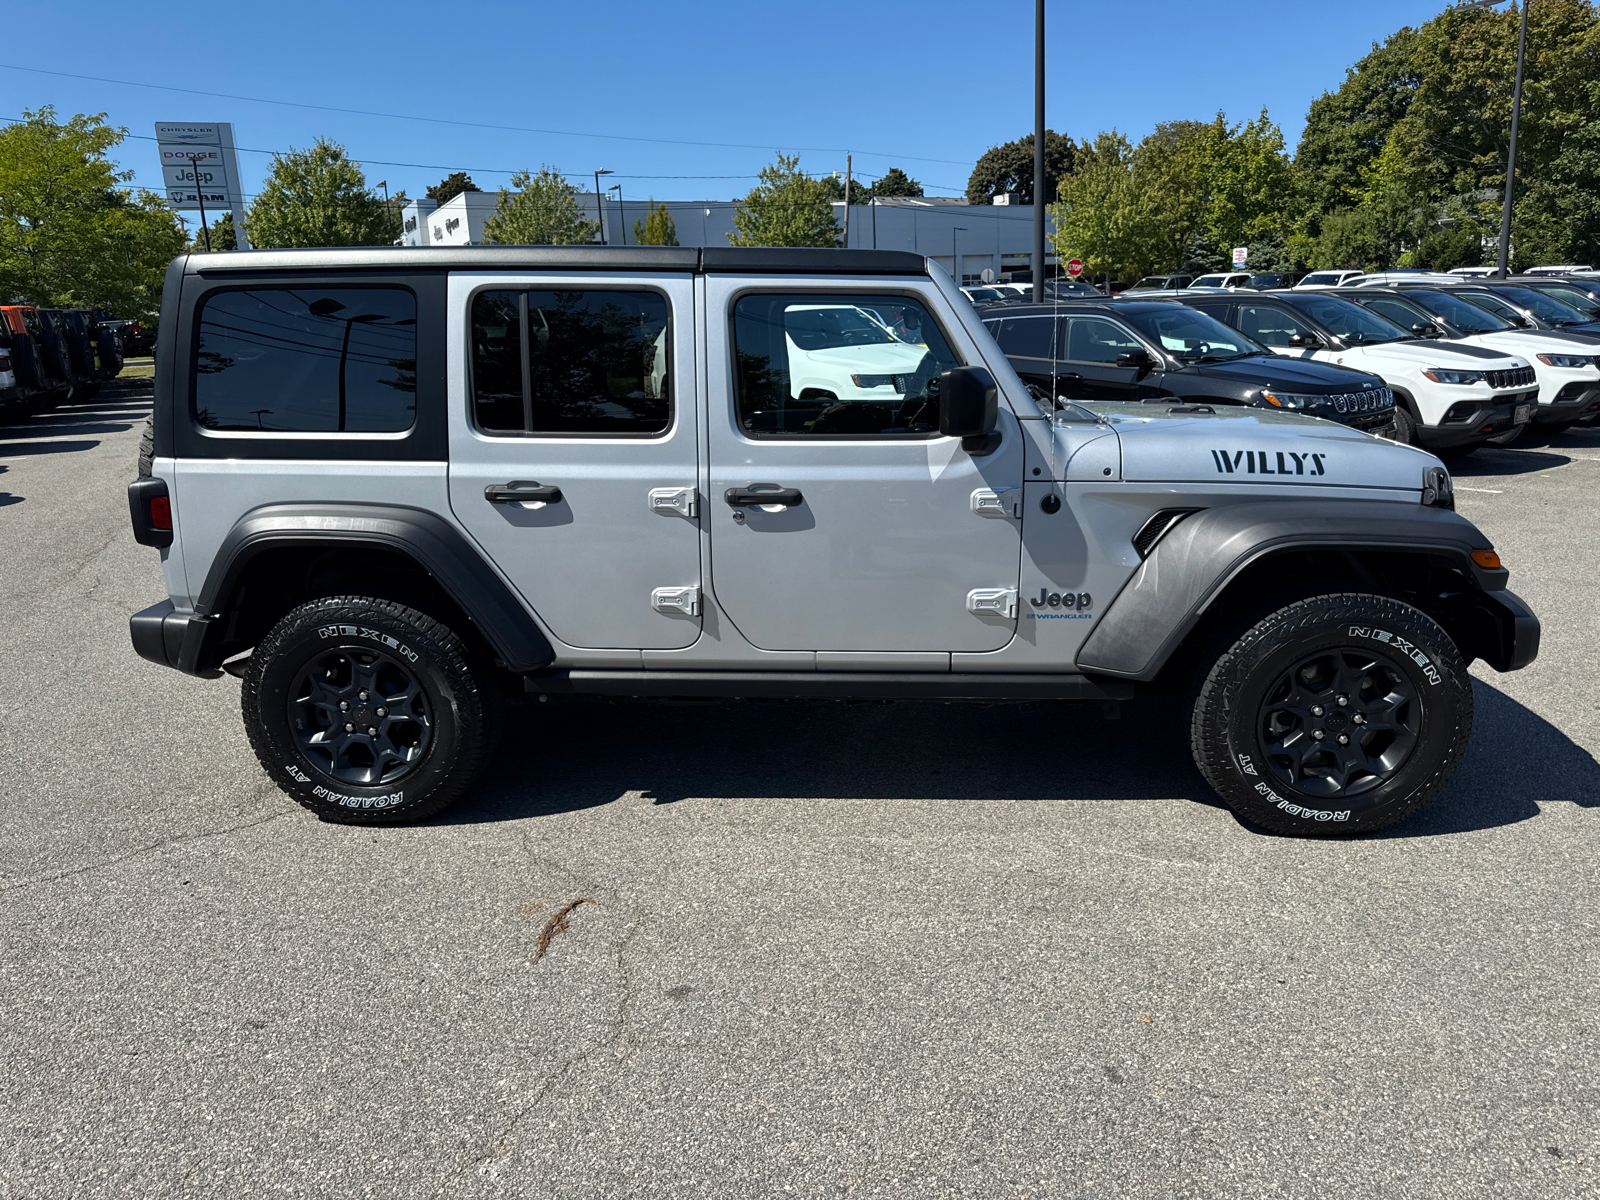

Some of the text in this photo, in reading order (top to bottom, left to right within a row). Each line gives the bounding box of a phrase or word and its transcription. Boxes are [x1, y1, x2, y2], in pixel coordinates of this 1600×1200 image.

[175, 169, 213, 184] Jeep
[1068, 263, 1083, 271] STOP
[1211, 449, 1326, 476] WILLYS
[1030, 588, 1092, 611] Jeep
[318, 625, 419, 663] NEXEN
[1348, 626, 1442, 686] NEXEN
[285, 765, 404, 809] ROADIAN AT
[1238, 752, 1351, 822] ROADIAN AT
